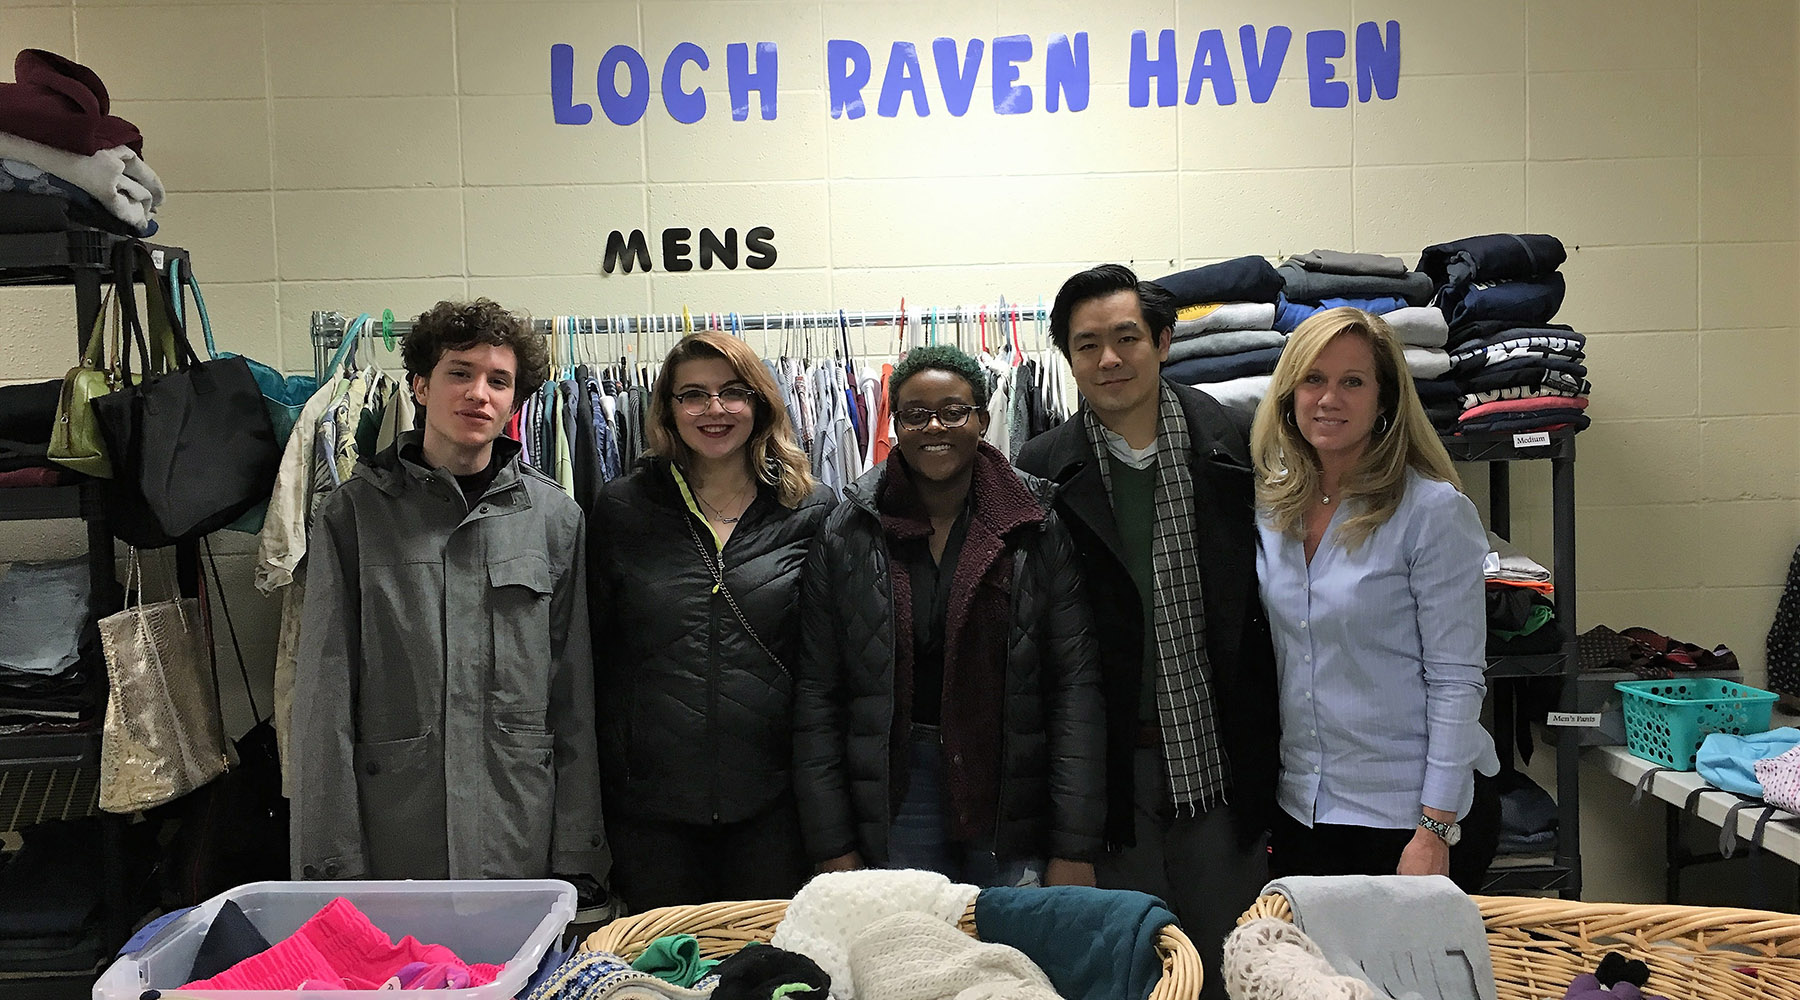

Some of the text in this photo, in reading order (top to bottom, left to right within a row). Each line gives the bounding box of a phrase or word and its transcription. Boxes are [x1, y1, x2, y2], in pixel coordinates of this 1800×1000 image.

[551, 21, 1400, 125] LOCH RAVEN HAVEN
[603, 227, 778, 273] MENS
[1516, 436, 1546, 445] Medium
[1552, 715, 1575, 723] Men's
